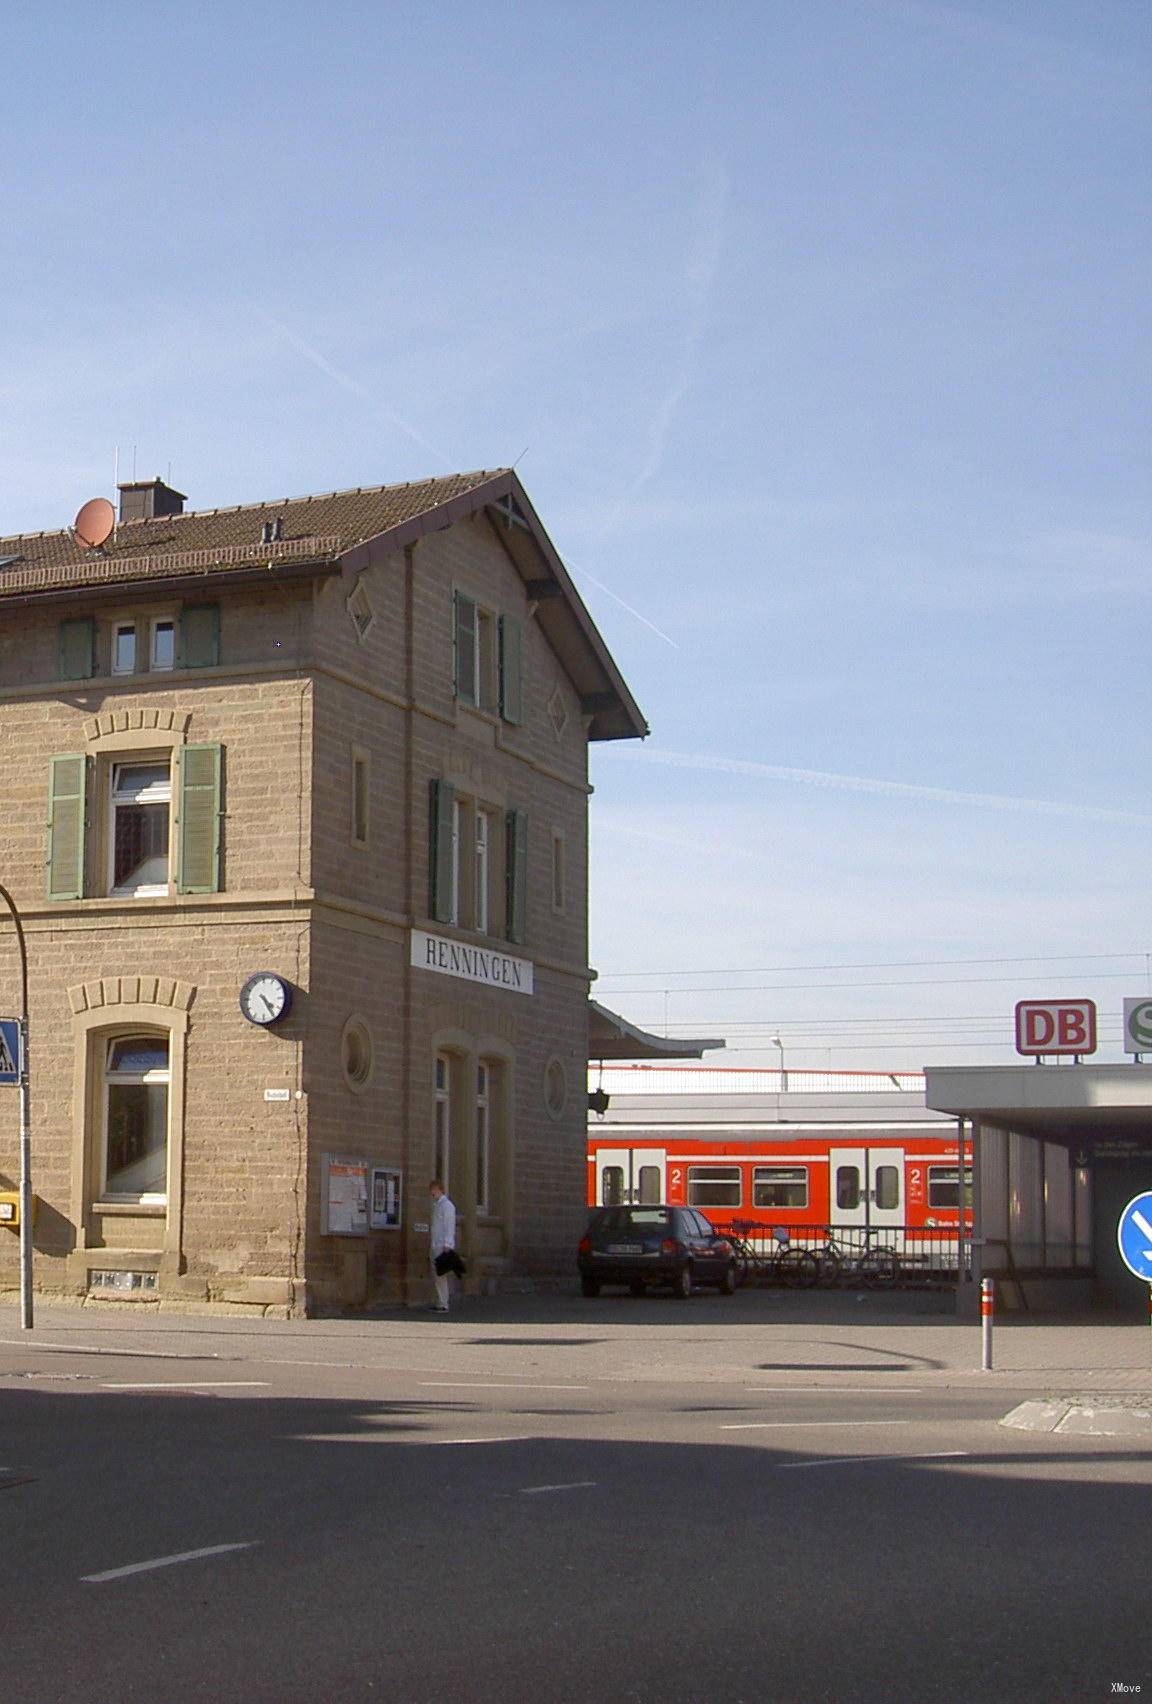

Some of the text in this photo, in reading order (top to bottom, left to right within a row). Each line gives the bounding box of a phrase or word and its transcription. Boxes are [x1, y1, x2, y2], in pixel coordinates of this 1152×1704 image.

[426, 937, 522, 987] RENNINGEN
[1026, 1009, 1087, 1046] DB
[671, 1169, 681, 1184] 2
[910, 1168, 921, 1184] 2
